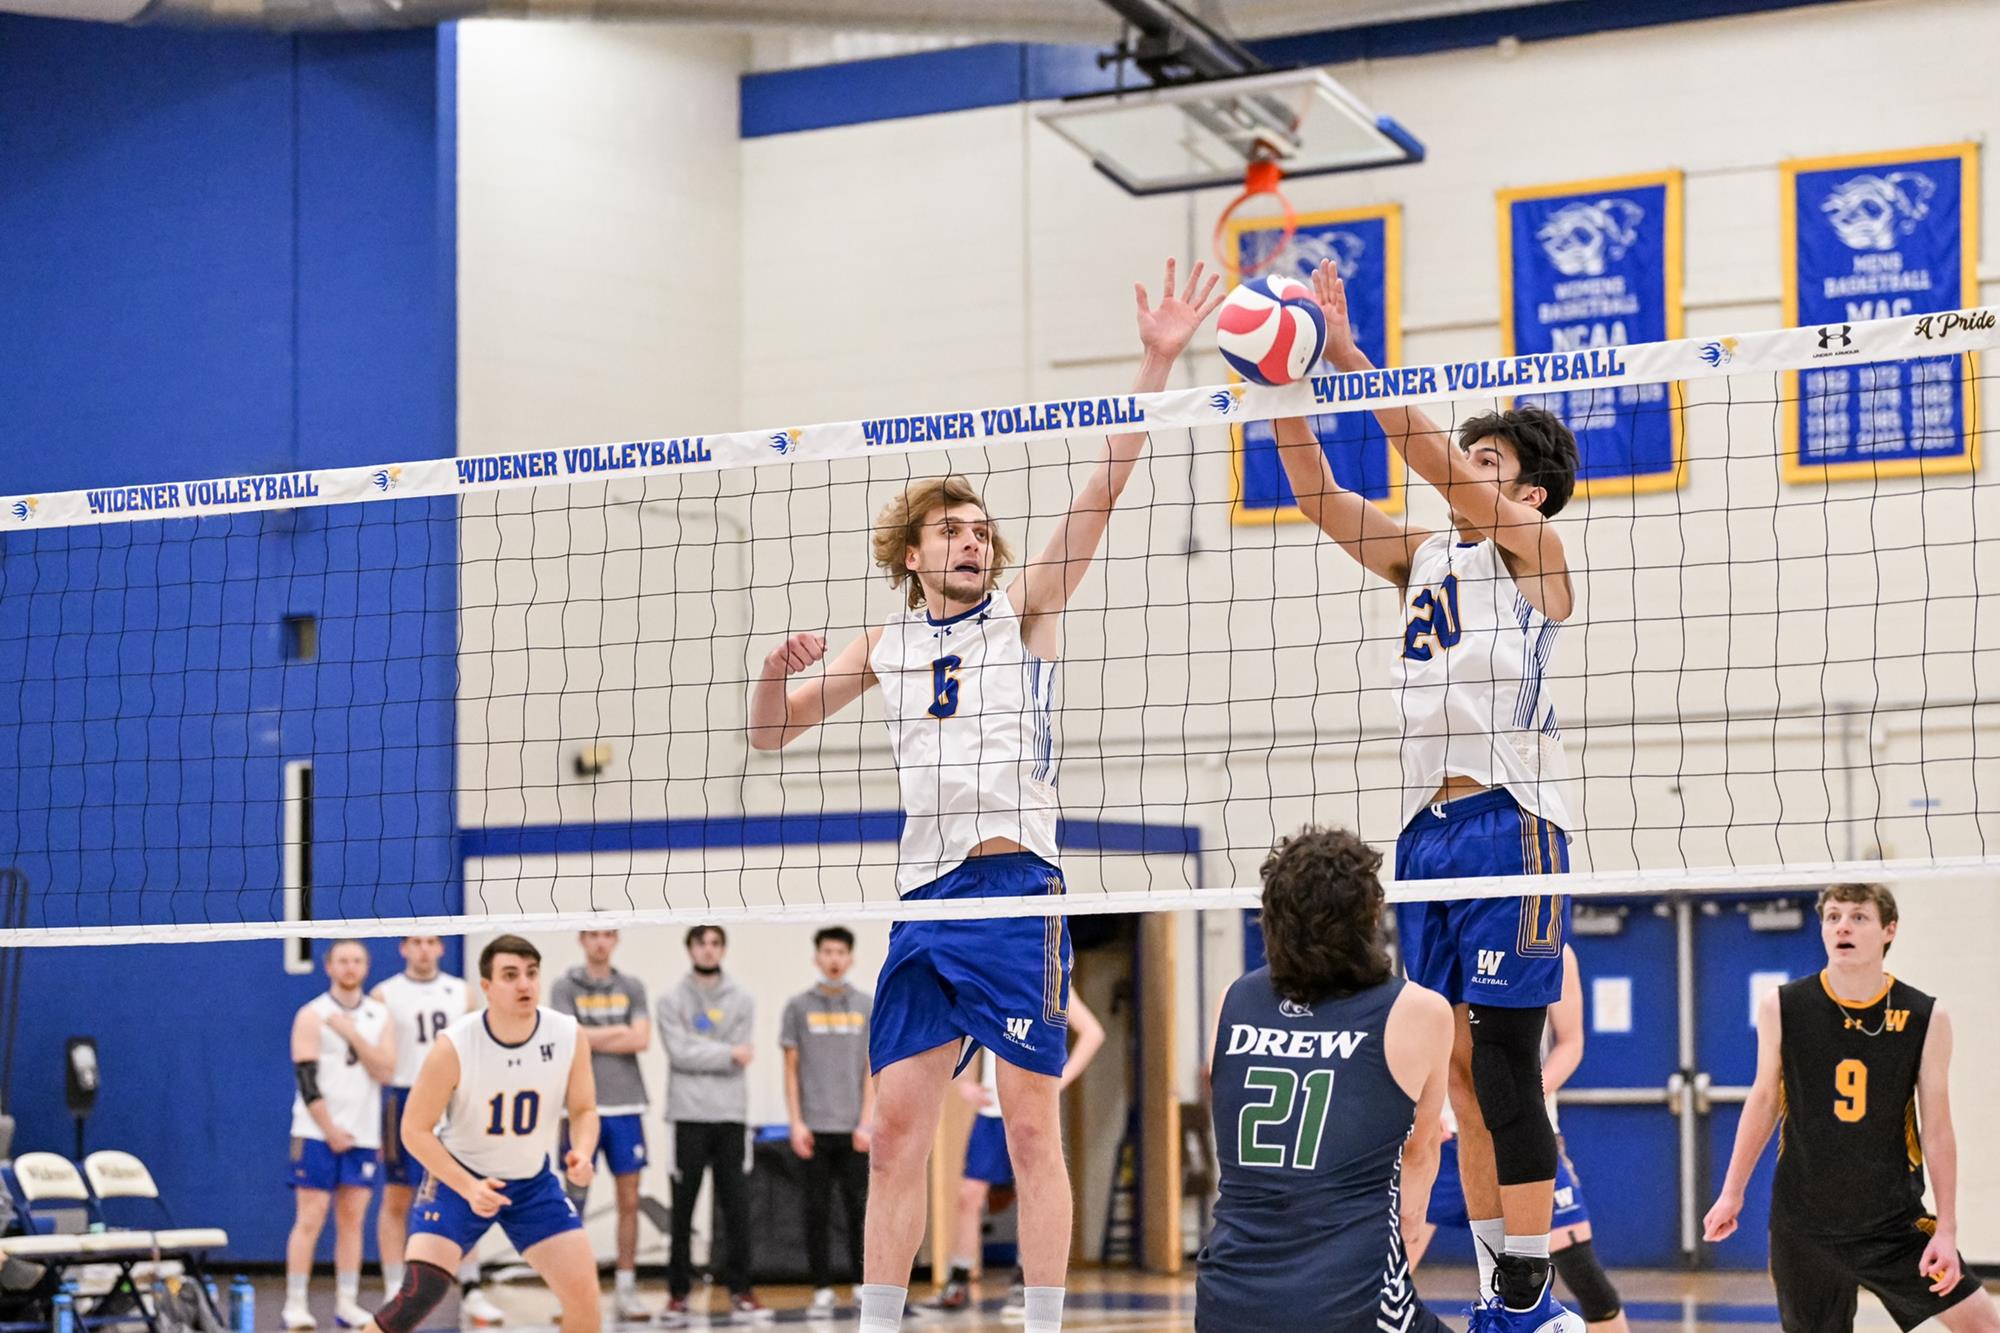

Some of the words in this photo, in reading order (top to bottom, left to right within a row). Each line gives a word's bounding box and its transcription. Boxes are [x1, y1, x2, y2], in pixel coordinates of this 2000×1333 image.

[1824, 269, 1932, 299] BASKETBALL
[1538, 293, 1640, 325] BASKETBALL
[1914, 316, 1934, 340] A
[1937, 310, 1996, 338] Pride
[1552, 321, 1628, 353] NCAA
[1311, 366, 1437, 403] WIDENER
[1443, 348, 1625, 391] VOLLEYBALL
[862, 412, 975, 446] WIDENER
[981, 396, 1145, 436] VOLLEYBALL
[456, 451, 558, 484] WIDENER
[563, 437, 712, 474] VOLLEYBALL
[86, 485, 180, 514] WIDENER
[185, 473, 319, 506] VOLLEYBALL
[1400, 573, 1462, 662] 20
[928, 654, 962, 719] 6
[1477, 949, 1505, 976] W
[416, 1010, 447, 1043] 18
[1007, 1017, 1033, 1040] W
[1884, 1009, 1910, 1032] W
[1225, 1024, 1368, 1059] DREW
[1833, 1059, 1868, 1123] 9
[486, 1089, 540, 1136] 10
[1239, 1066, 1334, 1170] 21
